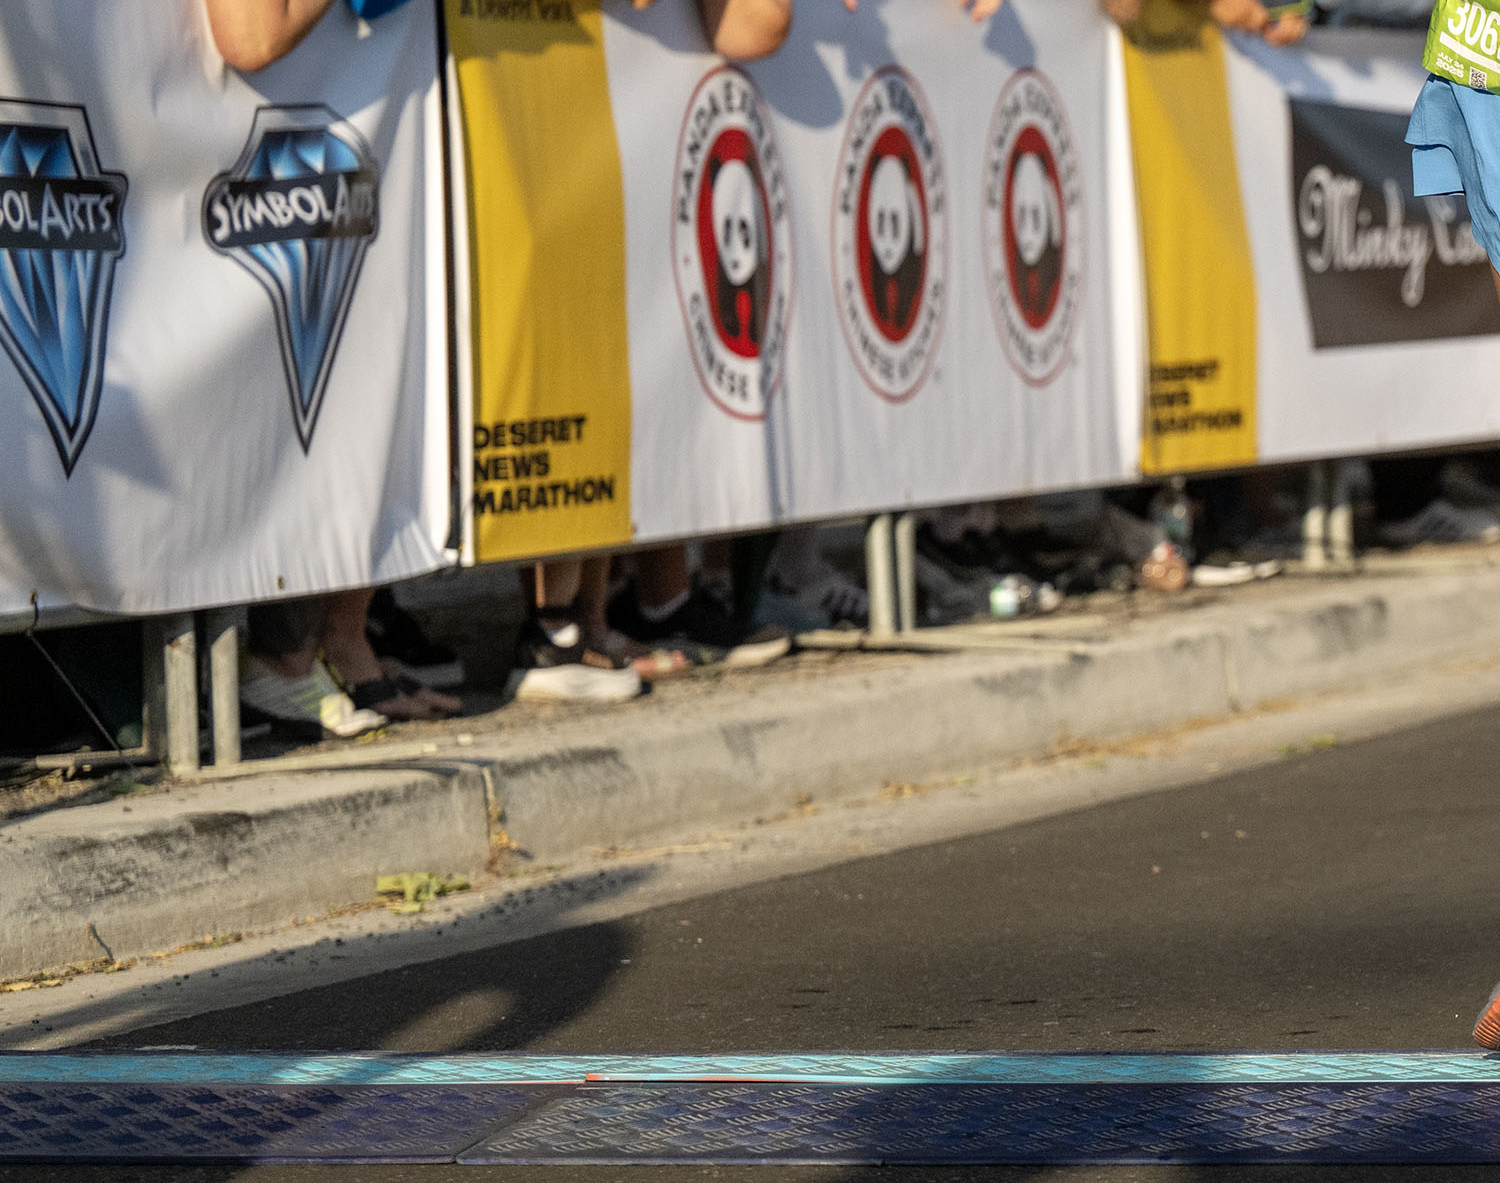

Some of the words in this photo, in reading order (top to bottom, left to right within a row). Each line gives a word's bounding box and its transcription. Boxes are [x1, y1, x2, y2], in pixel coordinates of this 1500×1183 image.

[1301, 164, 1432, 308] Minky
[473, 414, 586, 449] DESERET
[473, 451, 549, 482] NEWS
[473, 474, 615, 516] MARATHON
